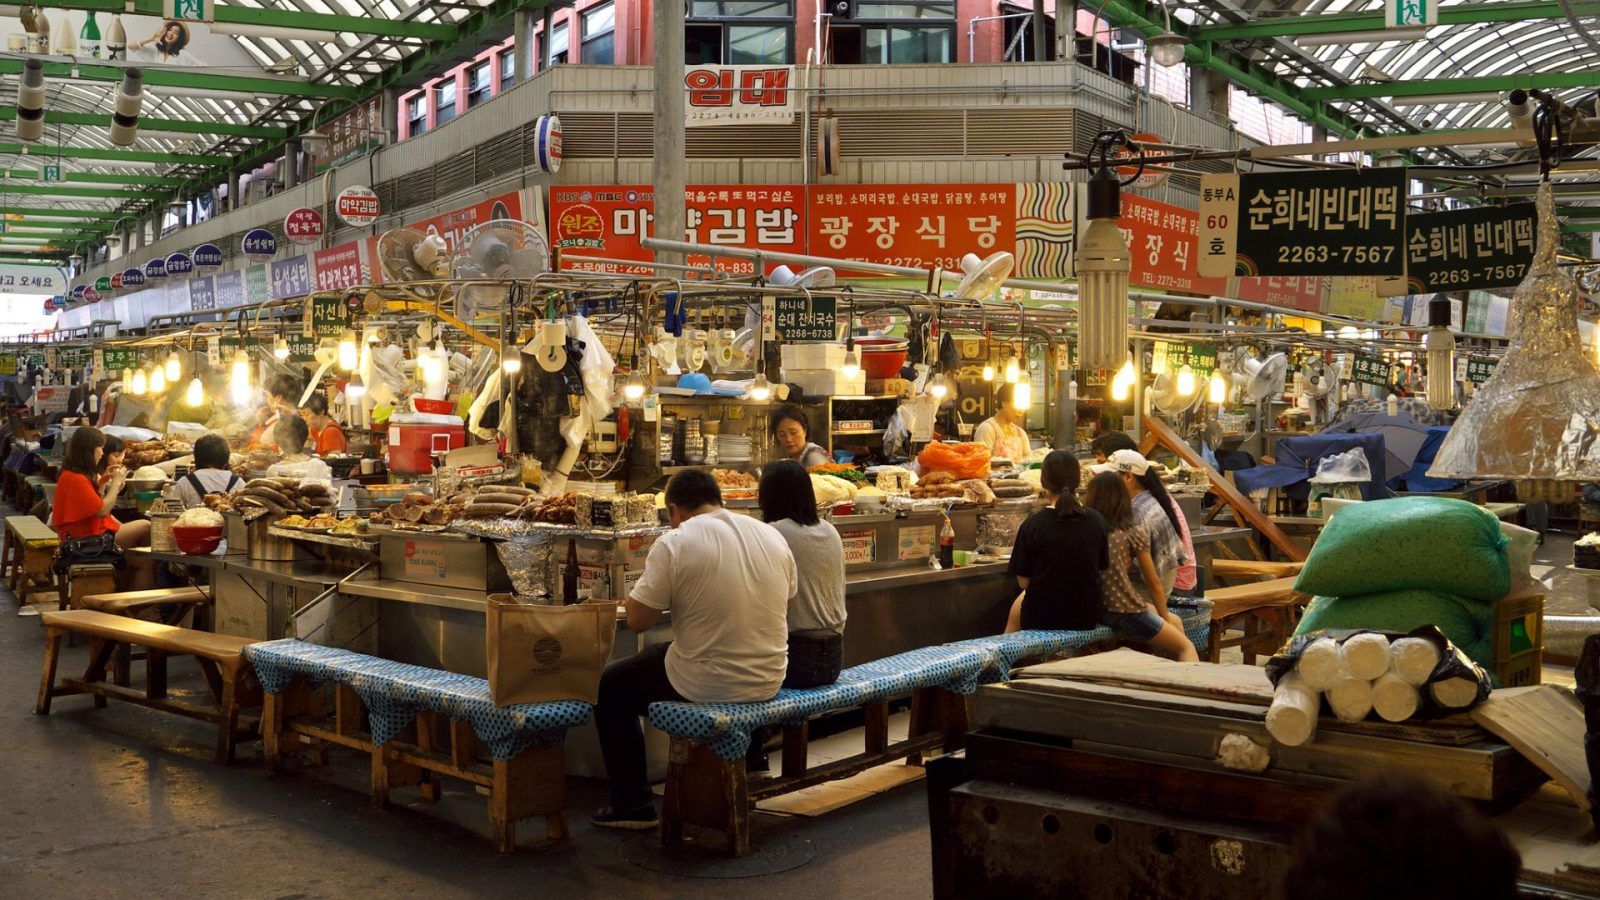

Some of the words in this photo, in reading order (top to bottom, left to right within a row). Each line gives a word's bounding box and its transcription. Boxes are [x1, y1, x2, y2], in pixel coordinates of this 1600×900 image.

[685, 69, 790, 107] 임대
[557, 192, 580, 202] KBS
[595, 192, 623, 202] MBC
[732, 190, 743, 200] 또
[746, 190, 769, 203] 먹고
[979, 191, 1007, 204] 추어탕
[1203, 187, 1235, 202] 동부A
[341, 199, 378, 213] 마약김밥
[561, 213, 601, 235] 원조
[1207, 214, 1228, 229] 60
[1208, 238, 1226, 255] 호
[1278, 244, 1395, 264] 2263-7567
[19, 276, 53, 287] 오세요
[1429, 263, 1527, 286] 2263-7567
[779, 300, 805, 310] 하니네
[778, 312, 795, 327] 순대
[785, 329, 833, 338] 2268-6738
[1355, 359, 1368, 372] 1호
